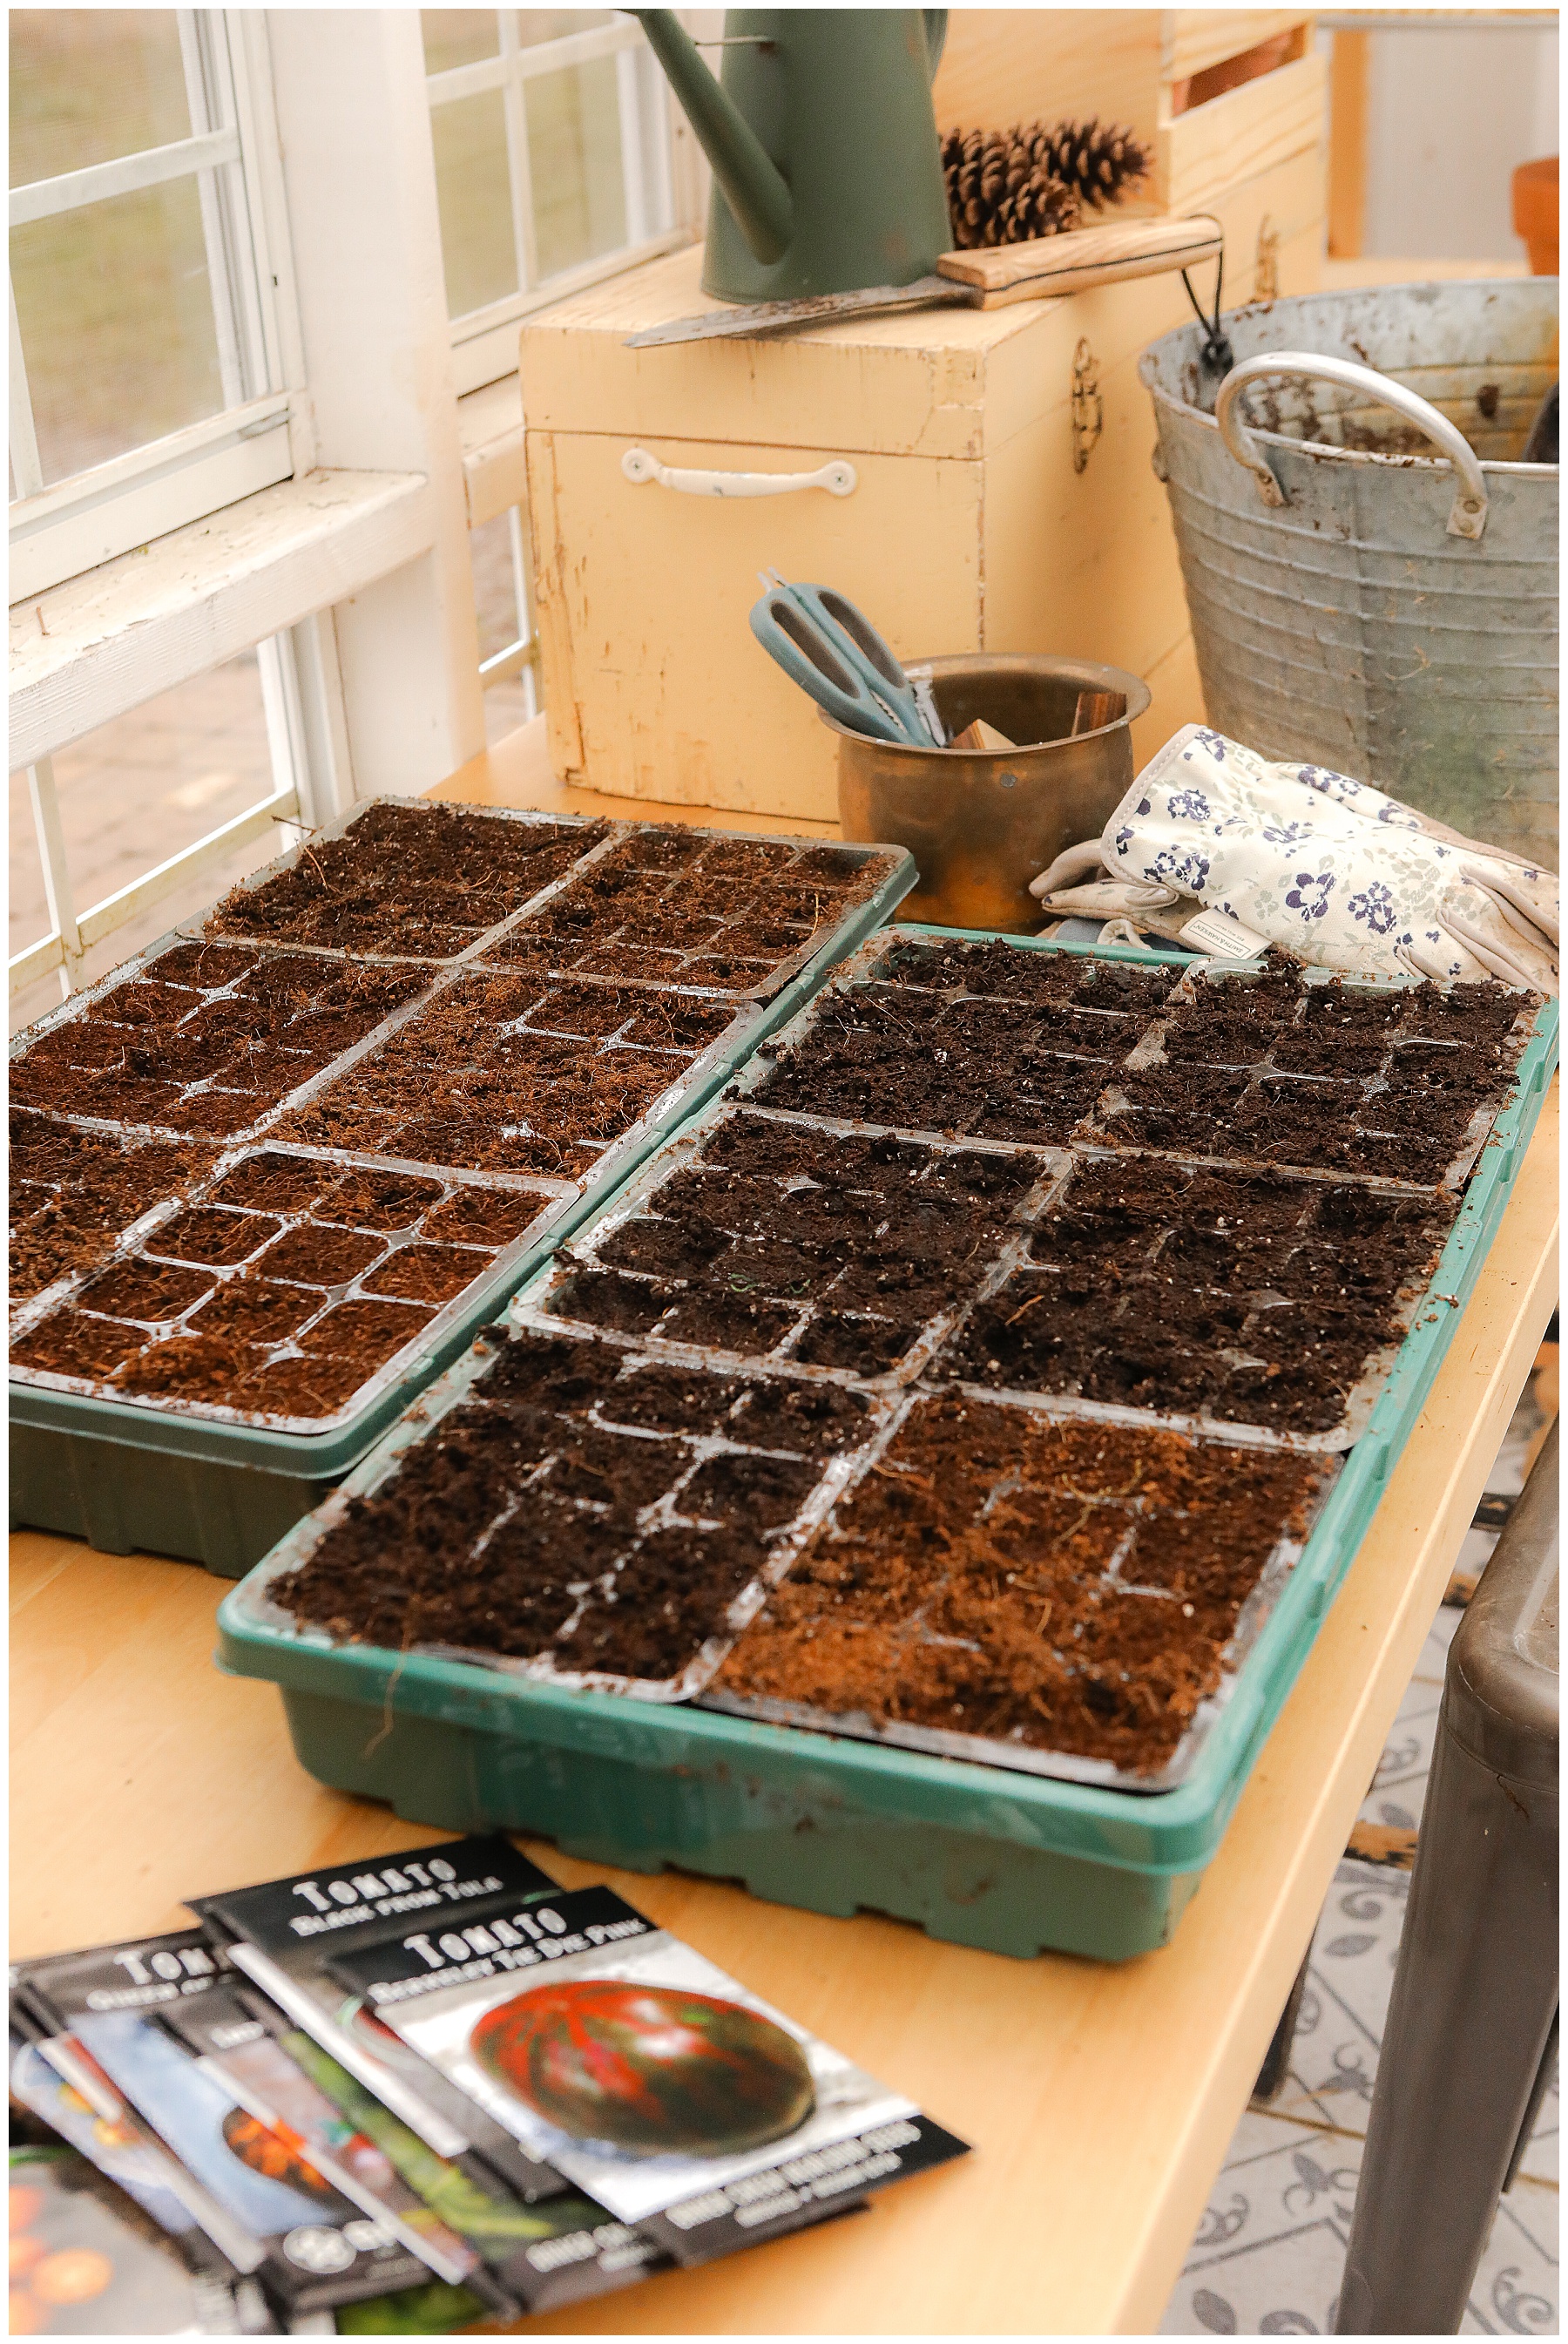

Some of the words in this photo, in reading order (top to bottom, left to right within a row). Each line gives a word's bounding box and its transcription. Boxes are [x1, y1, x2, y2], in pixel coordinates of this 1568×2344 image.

[1225, 941, 1243, 953] SMITH
[292, 1858, 456, 1912] TOMATO
[402, 1907, 567, 1968] TOMATO
[113, 1948, 217, 1985] TOM
